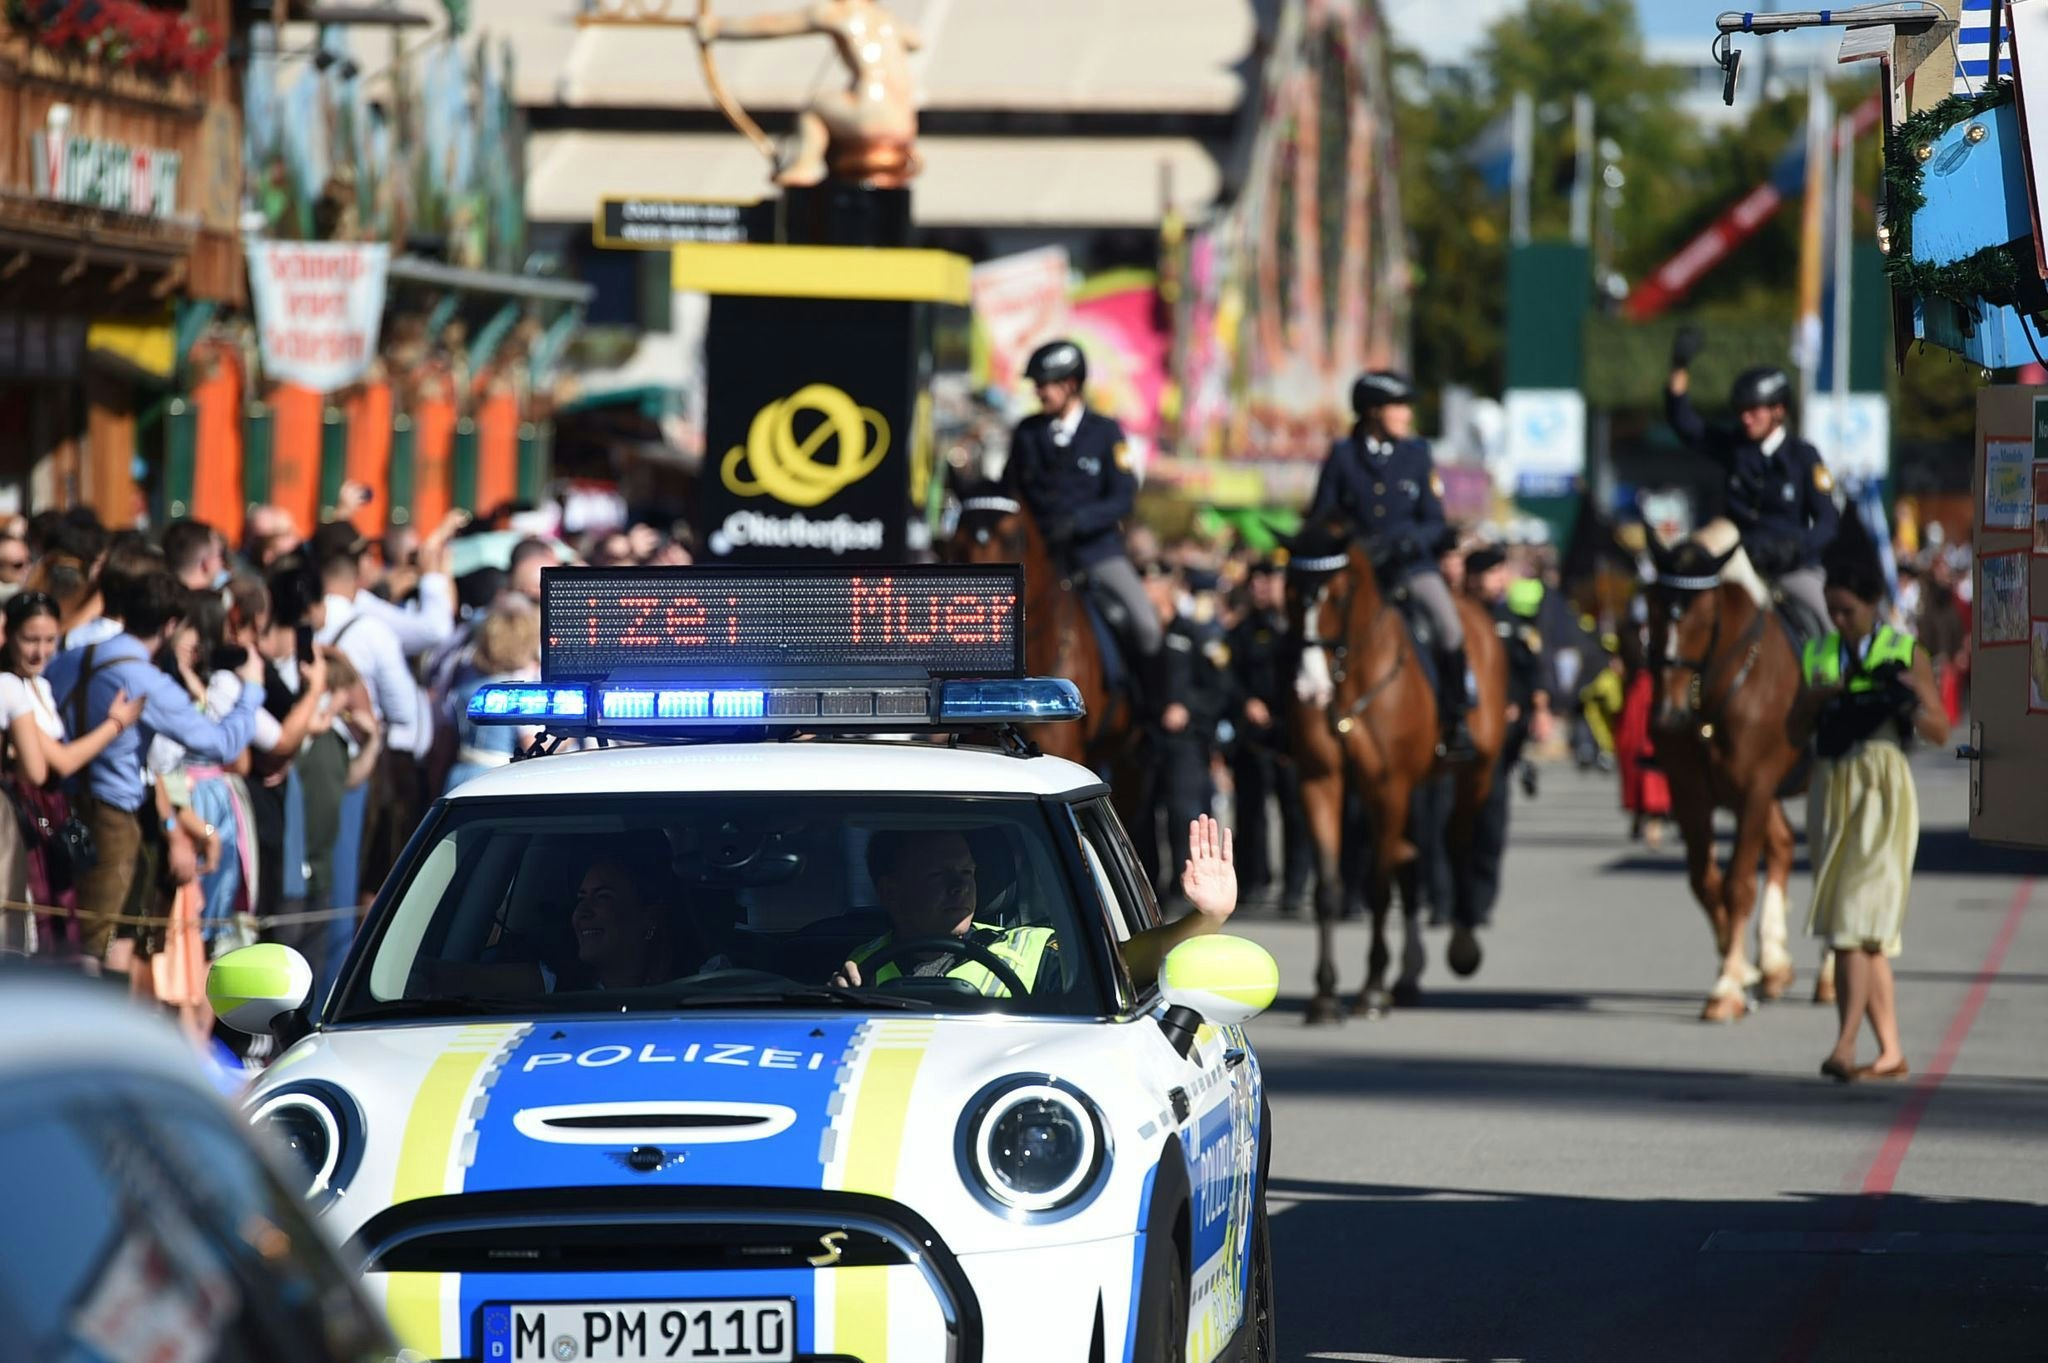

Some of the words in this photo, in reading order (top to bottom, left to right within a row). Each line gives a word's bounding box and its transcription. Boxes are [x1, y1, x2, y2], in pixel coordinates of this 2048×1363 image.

[723, 510, 884, 555] Oktoberfest
[550, 596, 738, 645] izei
[521, 1043, 825, 1073] POLIZEI
[807, 1231, 849, 1266] S
[491, 1340, 504, 1358] D
[516, 1312, 546, 1359] M
[583, 1311, 646, 1358] PM
[660, 1309, 784, 1357] 9110
